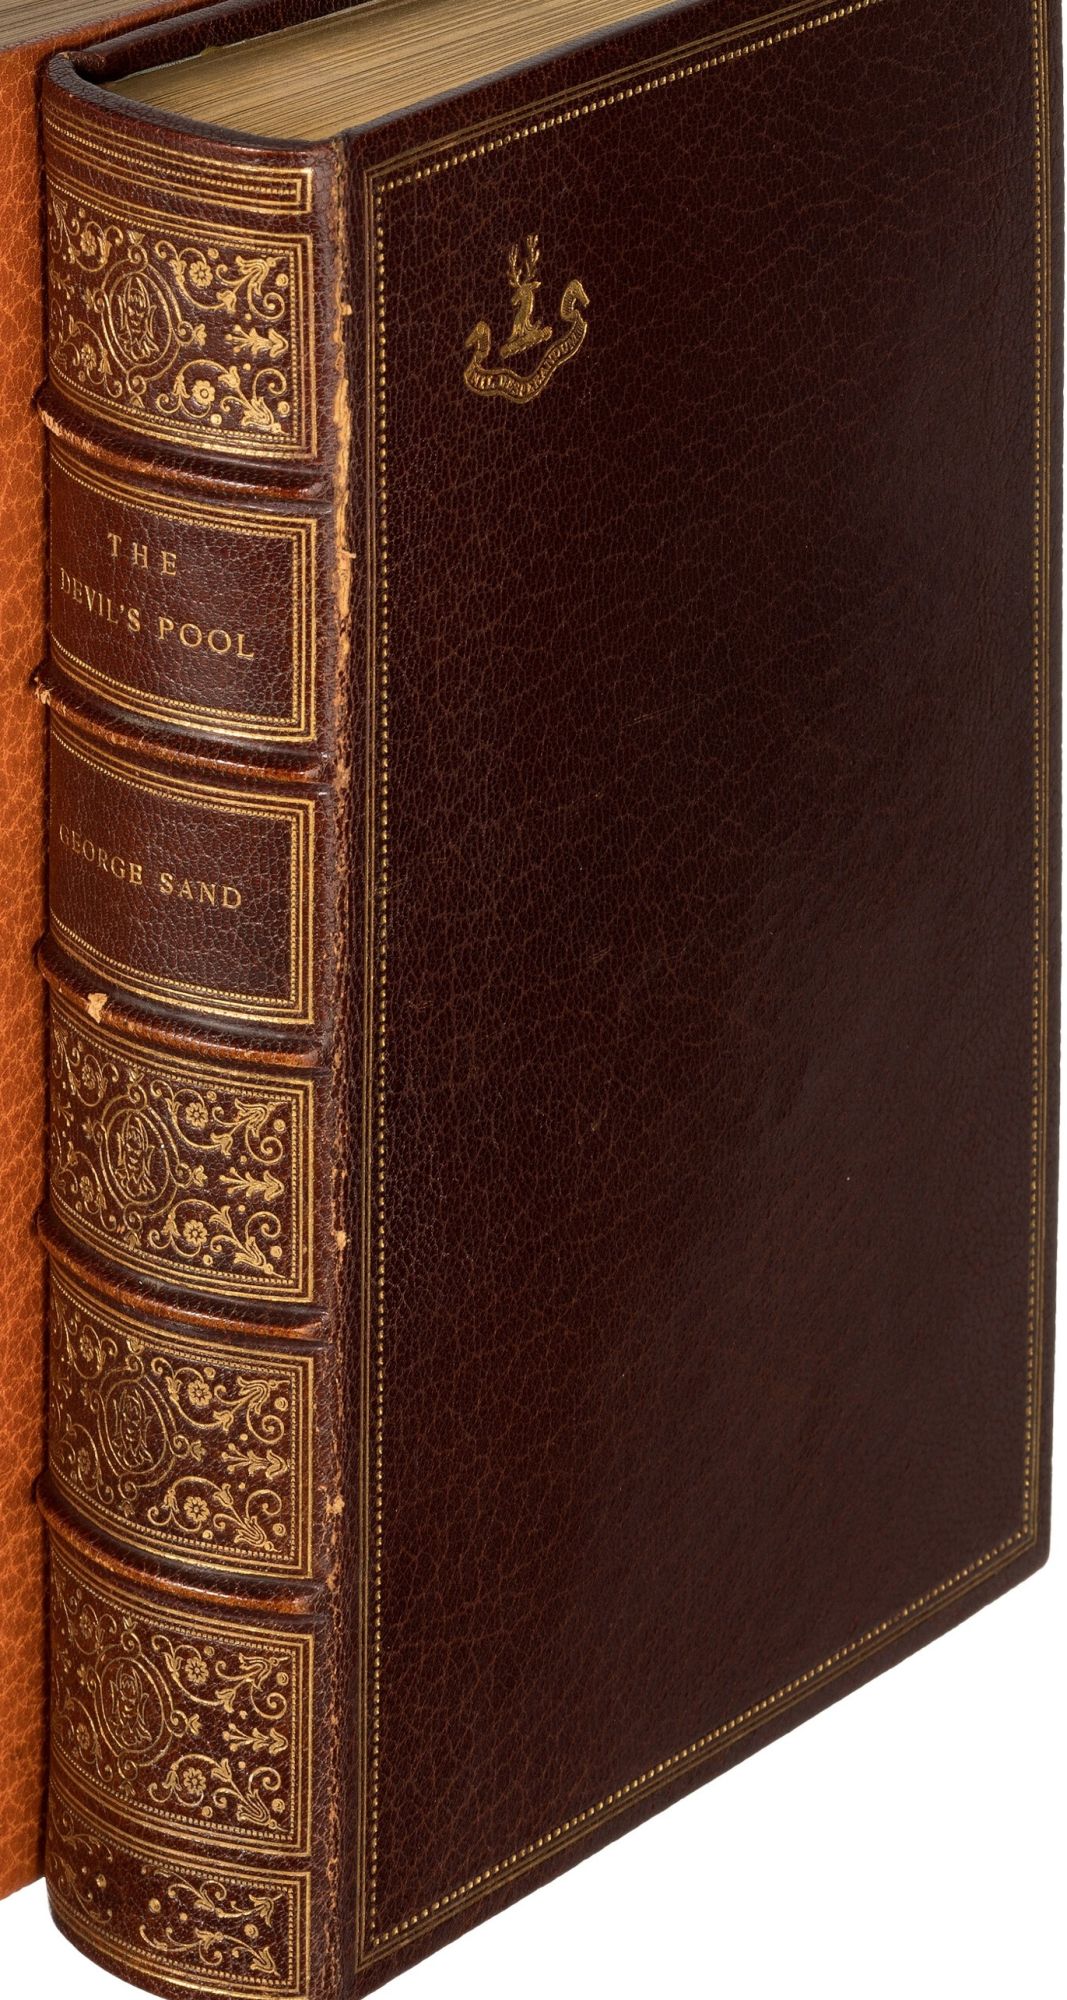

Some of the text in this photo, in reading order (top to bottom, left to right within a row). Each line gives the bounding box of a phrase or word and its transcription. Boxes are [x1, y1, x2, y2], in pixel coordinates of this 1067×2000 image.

[107, 532, 177, 576] THE
[60, 567, 254, 660] DEVIL'S POOL
[59, 823, 242, 909] GEORGE SAND
